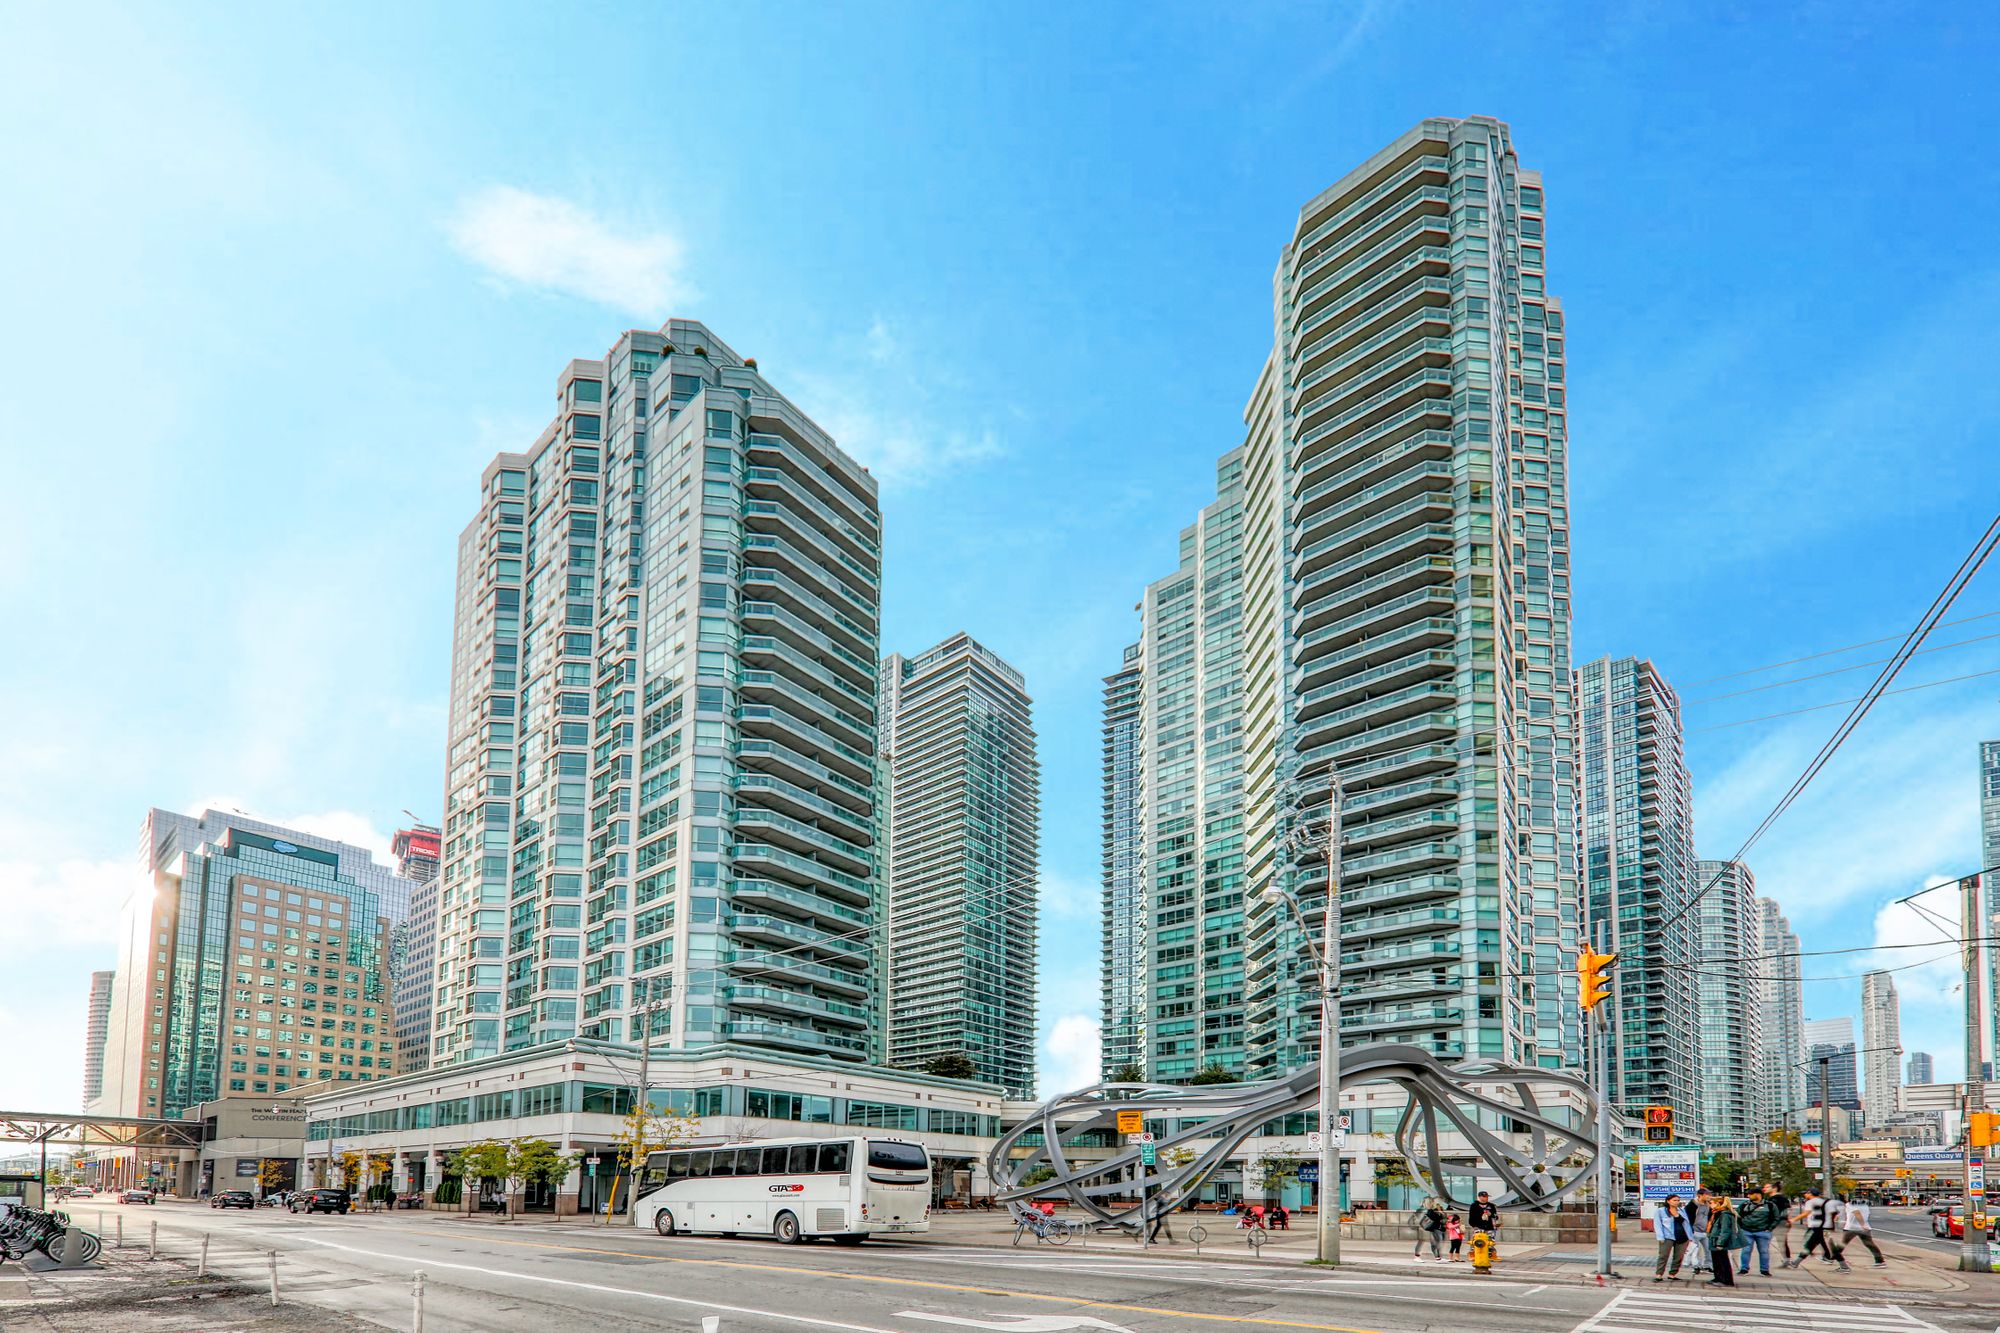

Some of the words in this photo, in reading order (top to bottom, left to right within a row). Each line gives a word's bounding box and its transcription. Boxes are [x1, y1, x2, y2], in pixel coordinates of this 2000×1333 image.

[411, 846, 437, 856] TRIDEL
[1934, 1152, 1954, 1160] Quay
[768, 1184, 788, 1192] GTA
